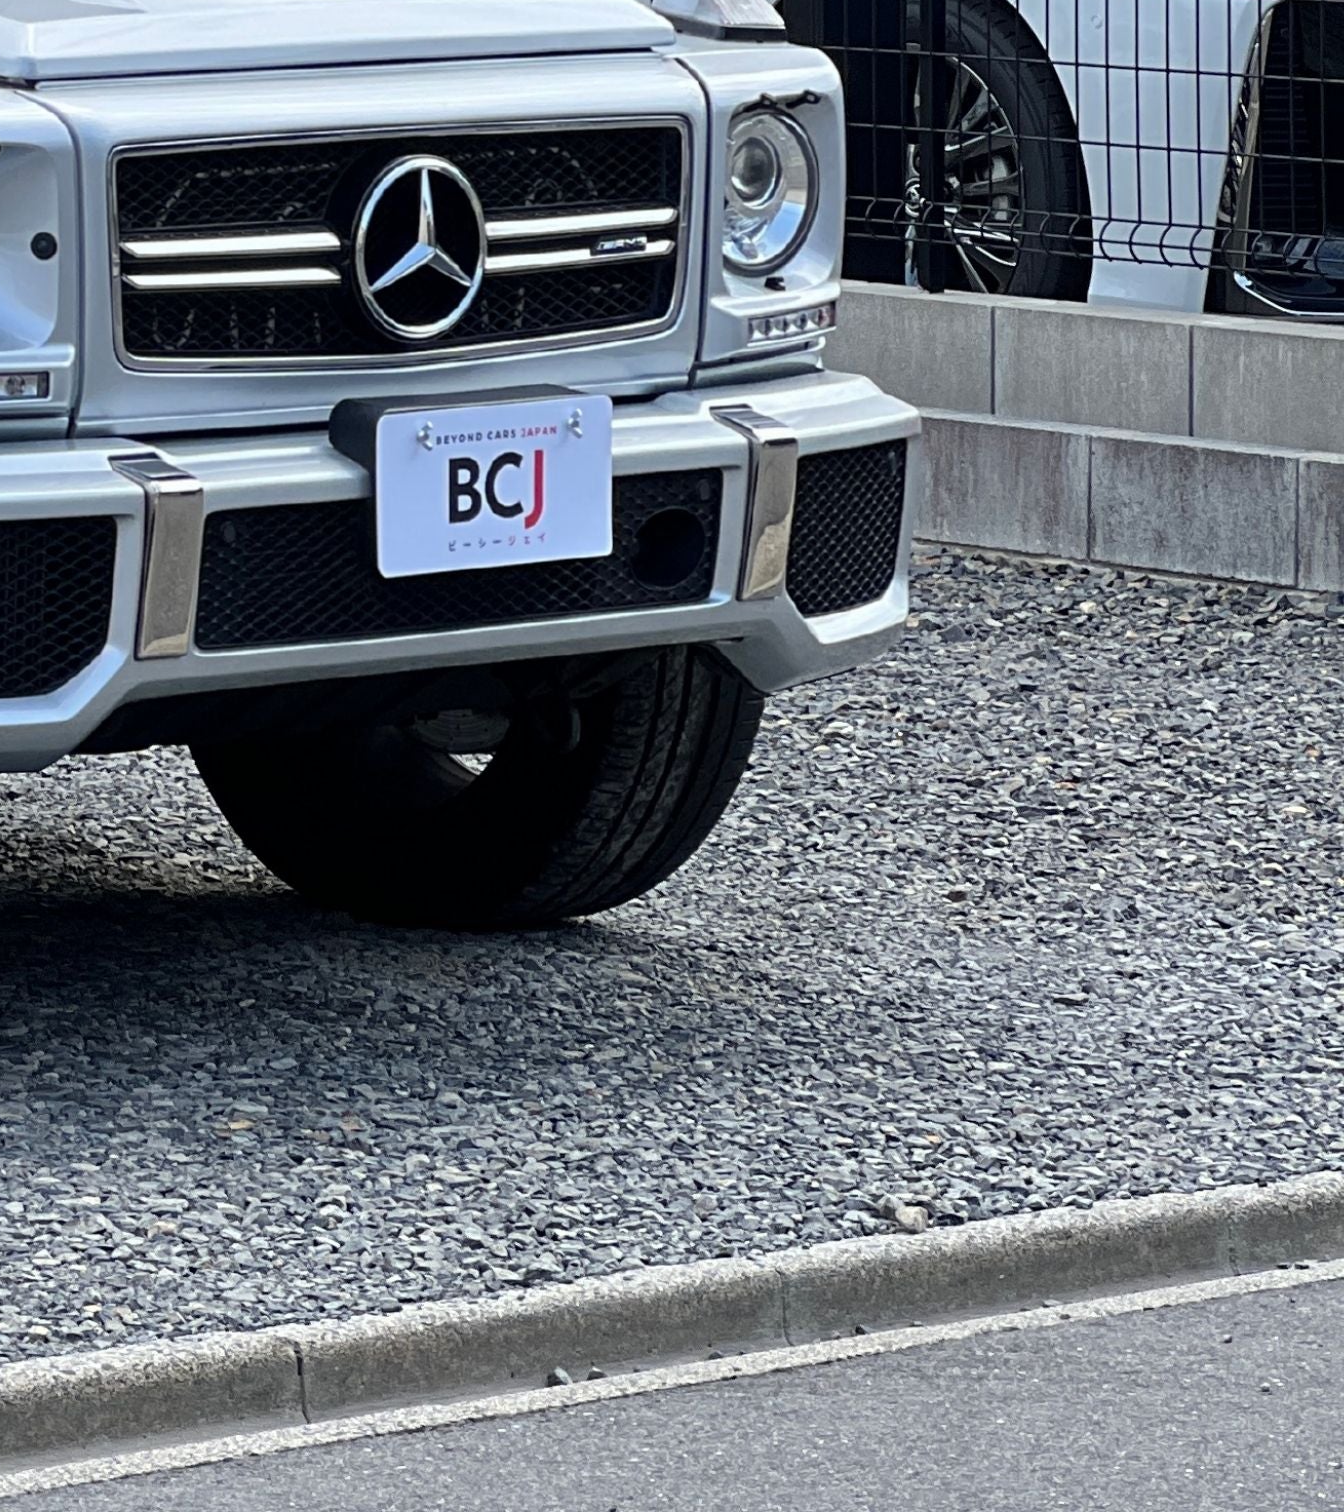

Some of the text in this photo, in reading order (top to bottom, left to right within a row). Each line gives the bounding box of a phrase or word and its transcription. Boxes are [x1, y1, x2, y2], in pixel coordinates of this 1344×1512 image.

[436, 425, 557, 445] BEYOND CARS JAPAN
[447, 449, 544, 529] BCJ
